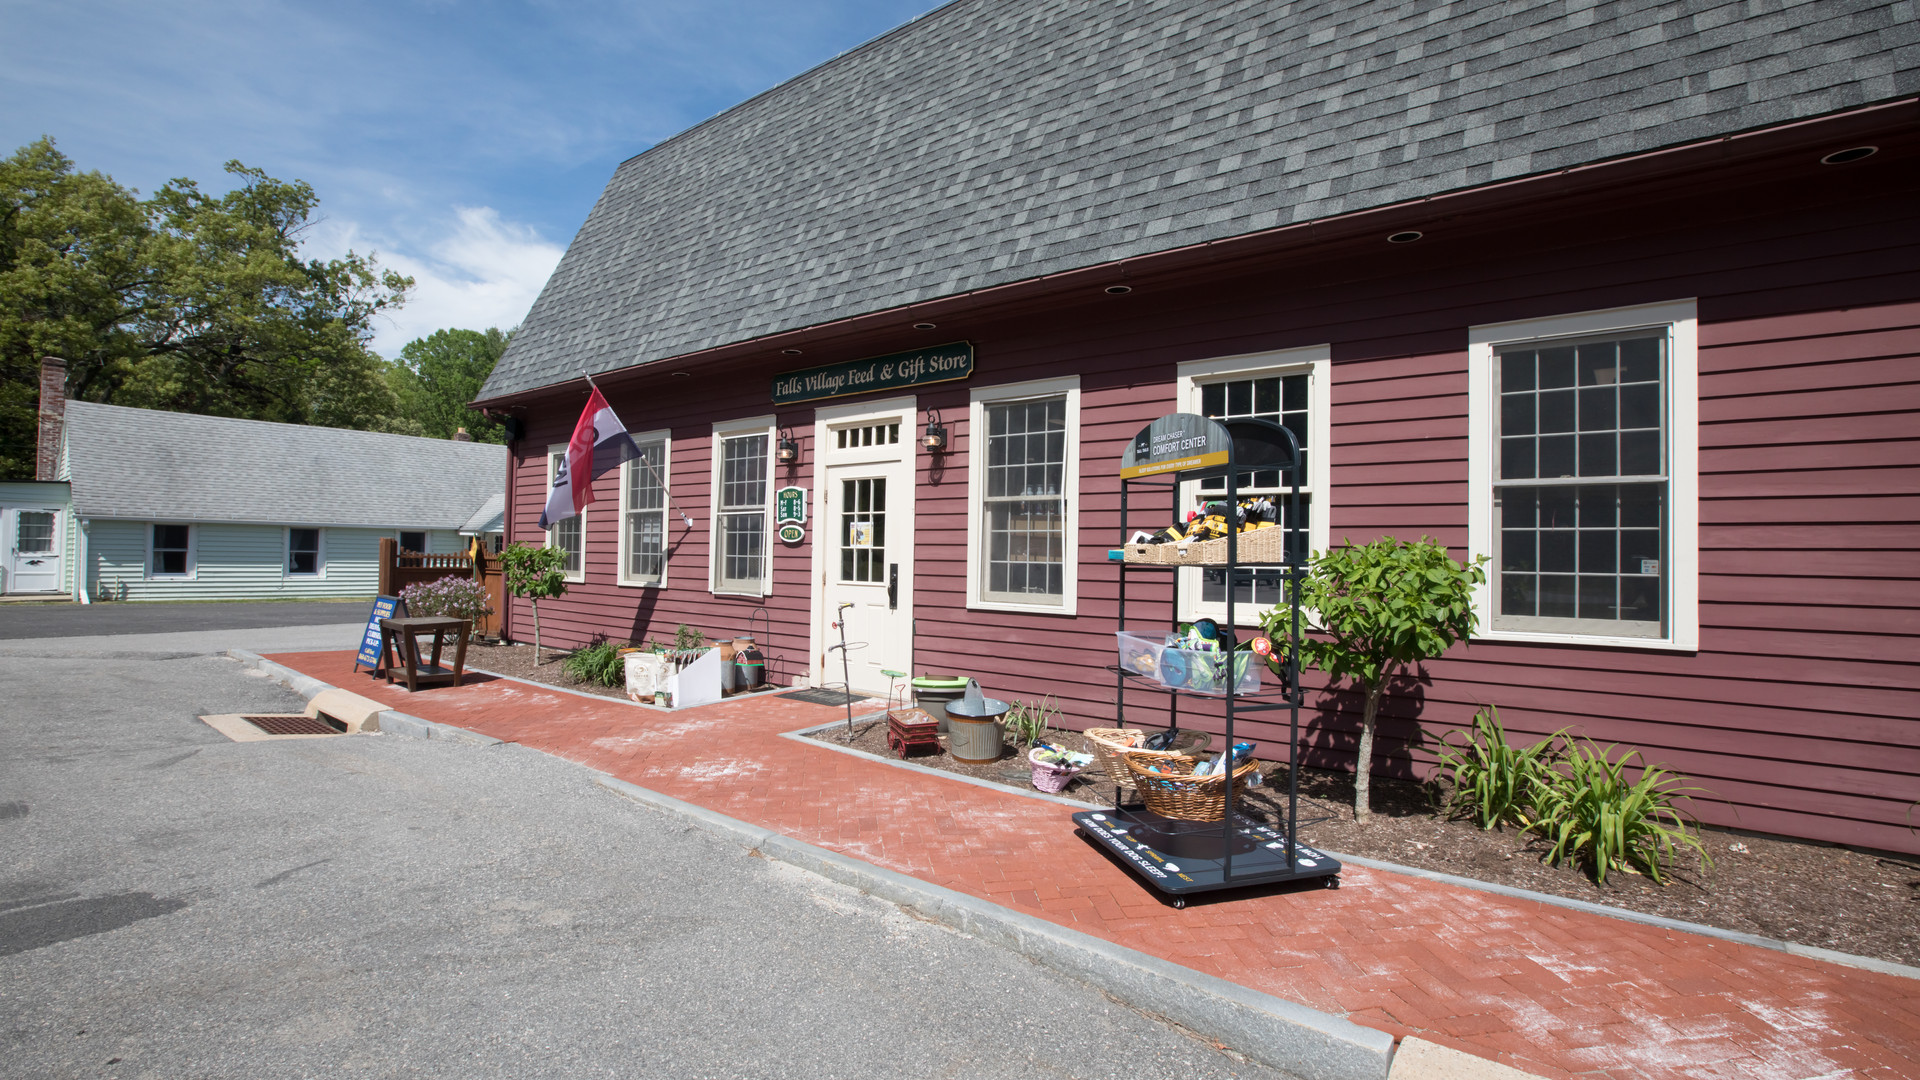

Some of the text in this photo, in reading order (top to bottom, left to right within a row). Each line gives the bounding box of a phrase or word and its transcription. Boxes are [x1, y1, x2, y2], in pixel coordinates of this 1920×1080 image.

[776, 354, 968, 396] Falls Village Feed & Gift Store
[1152, 441, 1180, 456] COMFORT
[1180, 436, 1207, 450] CENTER
[1153, 433, 1166, 444] DREAM
[784, 530, 798, 538] OPEN
[1109, 837, 1130, 851] YOUR
[1124, 850, 1143, 861] DOG
[1177, 872, 1194, 882] NEST
